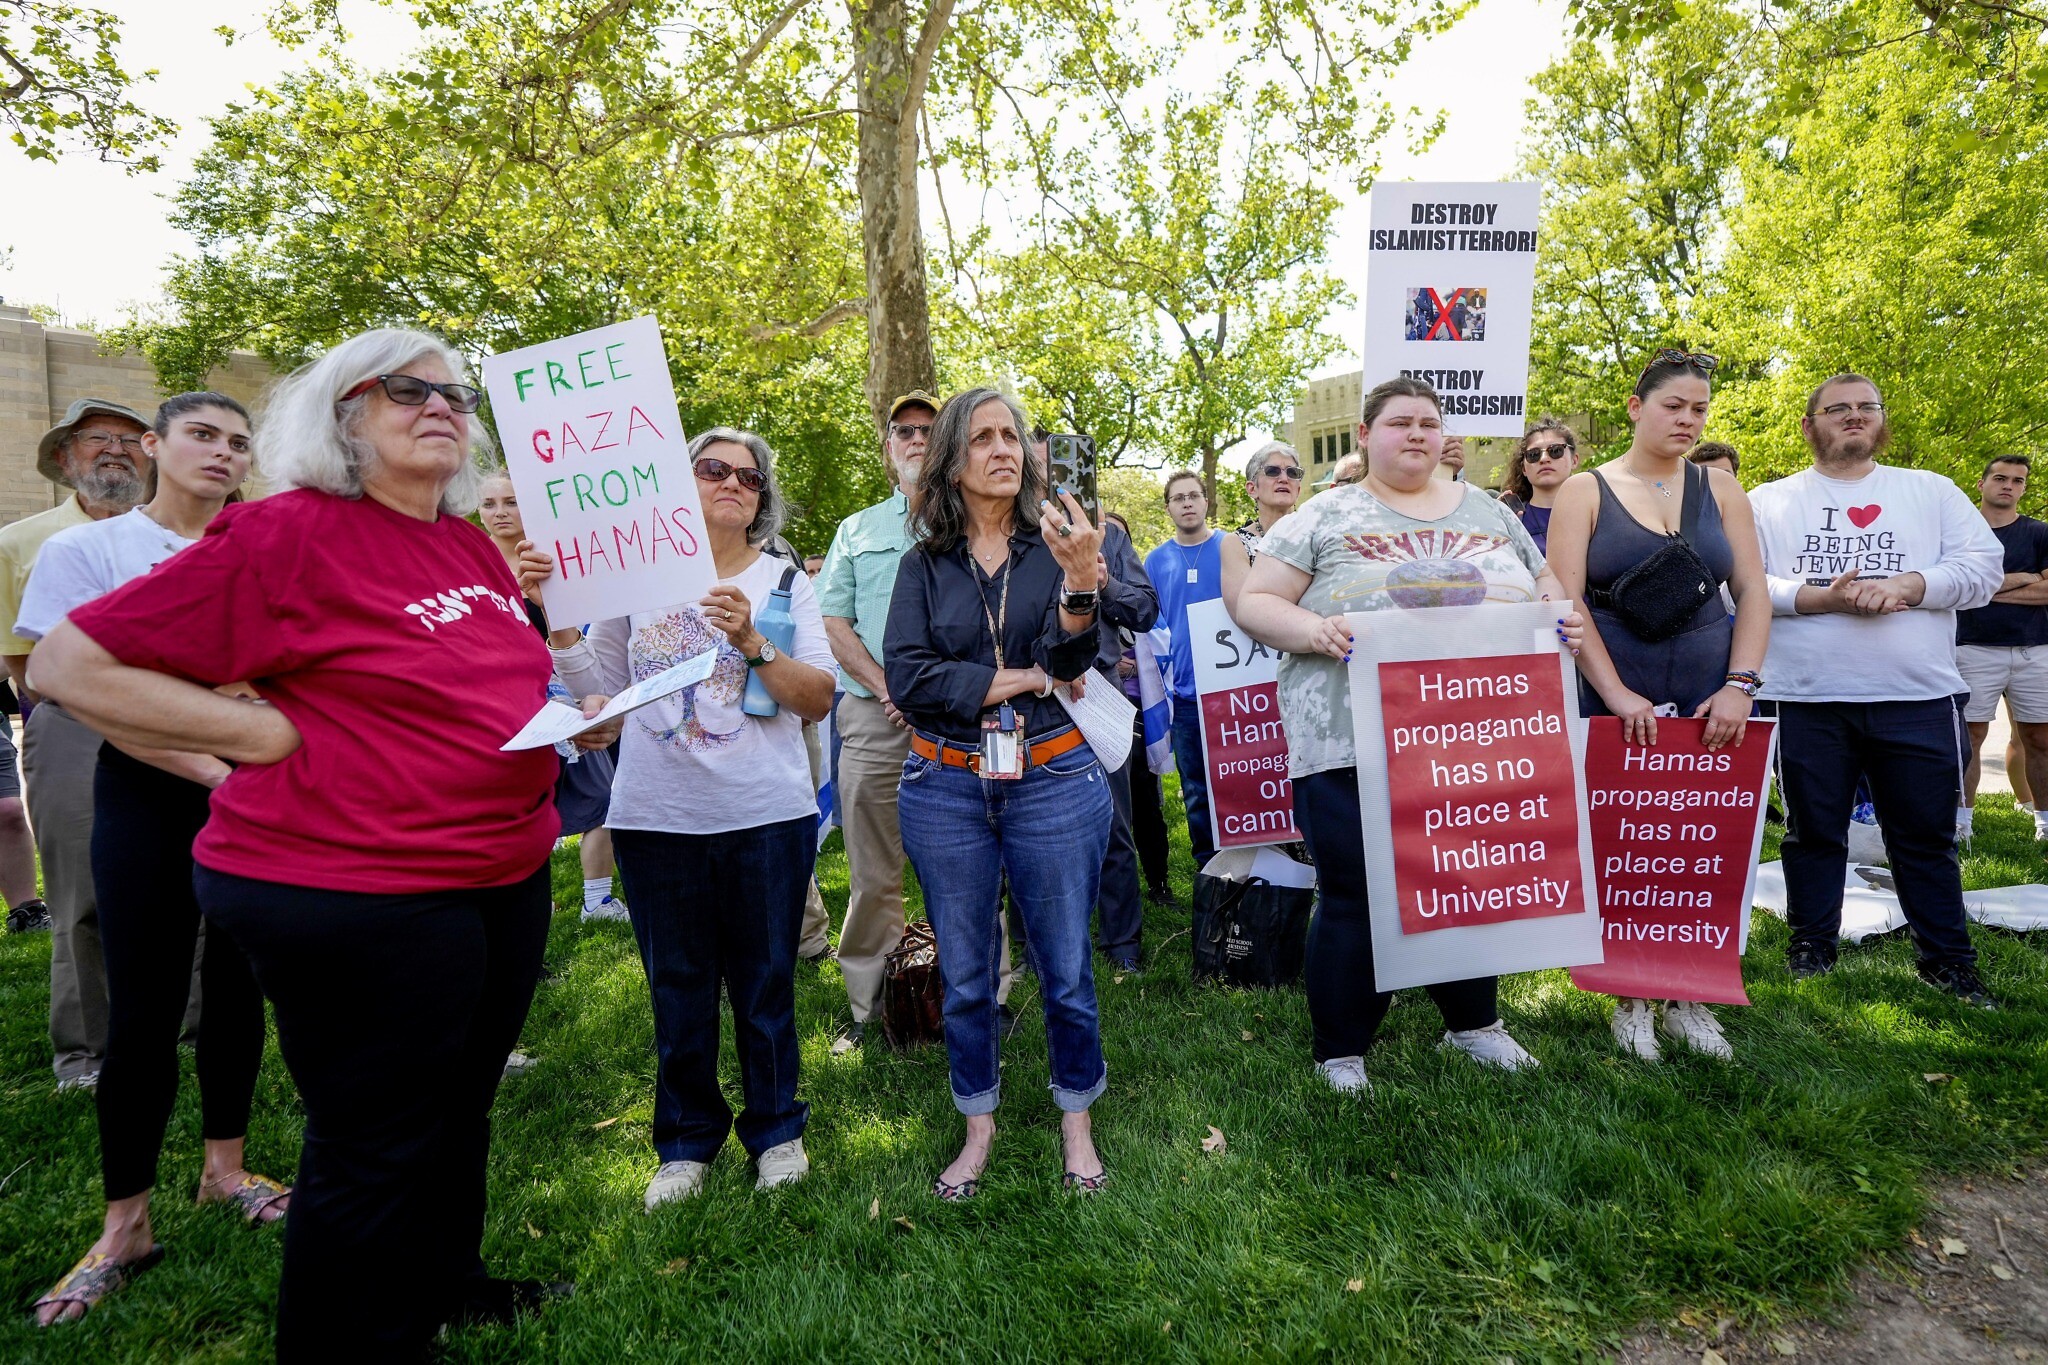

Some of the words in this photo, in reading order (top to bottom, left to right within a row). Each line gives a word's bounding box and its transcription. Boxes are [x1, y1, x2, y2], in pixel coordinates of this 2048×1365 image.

[1411, 203, 1498, 225] DESTROY
[1369, 229, 1457, 251] ISLAMIST
[1457, 230, 1537, 252] TERROR!
[512, 342, 632, 403] FREE
[532, 405, 665, 463] GAZA
[545, 462, 659, 519] FROM
[1820, 507, 1839, 532] I
[554, 506, 698, 581] HAMAS
[1802, 531, 1896, 554] BEING
[1792, 552, 1906, 575] JEWISH
[1215, 629, 1284, 669] SA
[1419, 672, 1529, 702] Hamas
[1229, 690, 1270, 717] No
[1393, 709, 1561, 753] propaganda
[1431, 759, 1488, 787] has
[1496, 757, 1535, 781] no
[1623, 747, 1731, 772] Hamas
[1590, 786, 1754, 812] propaganda
[1425, 800, 1510, 837] place
[1519, 794, 1549, 821] at
[1619, 818, 1671, 841] has
[1680, 823, 1717, 841] no
[1432, 839, 1546, 873] Indiana
[1604, 851, 1685, 878] place
[1693, 854, 1723, 875] at
[1416, 876, 1570, 918] University
[1605, 884, 1712, 908] Indiana
